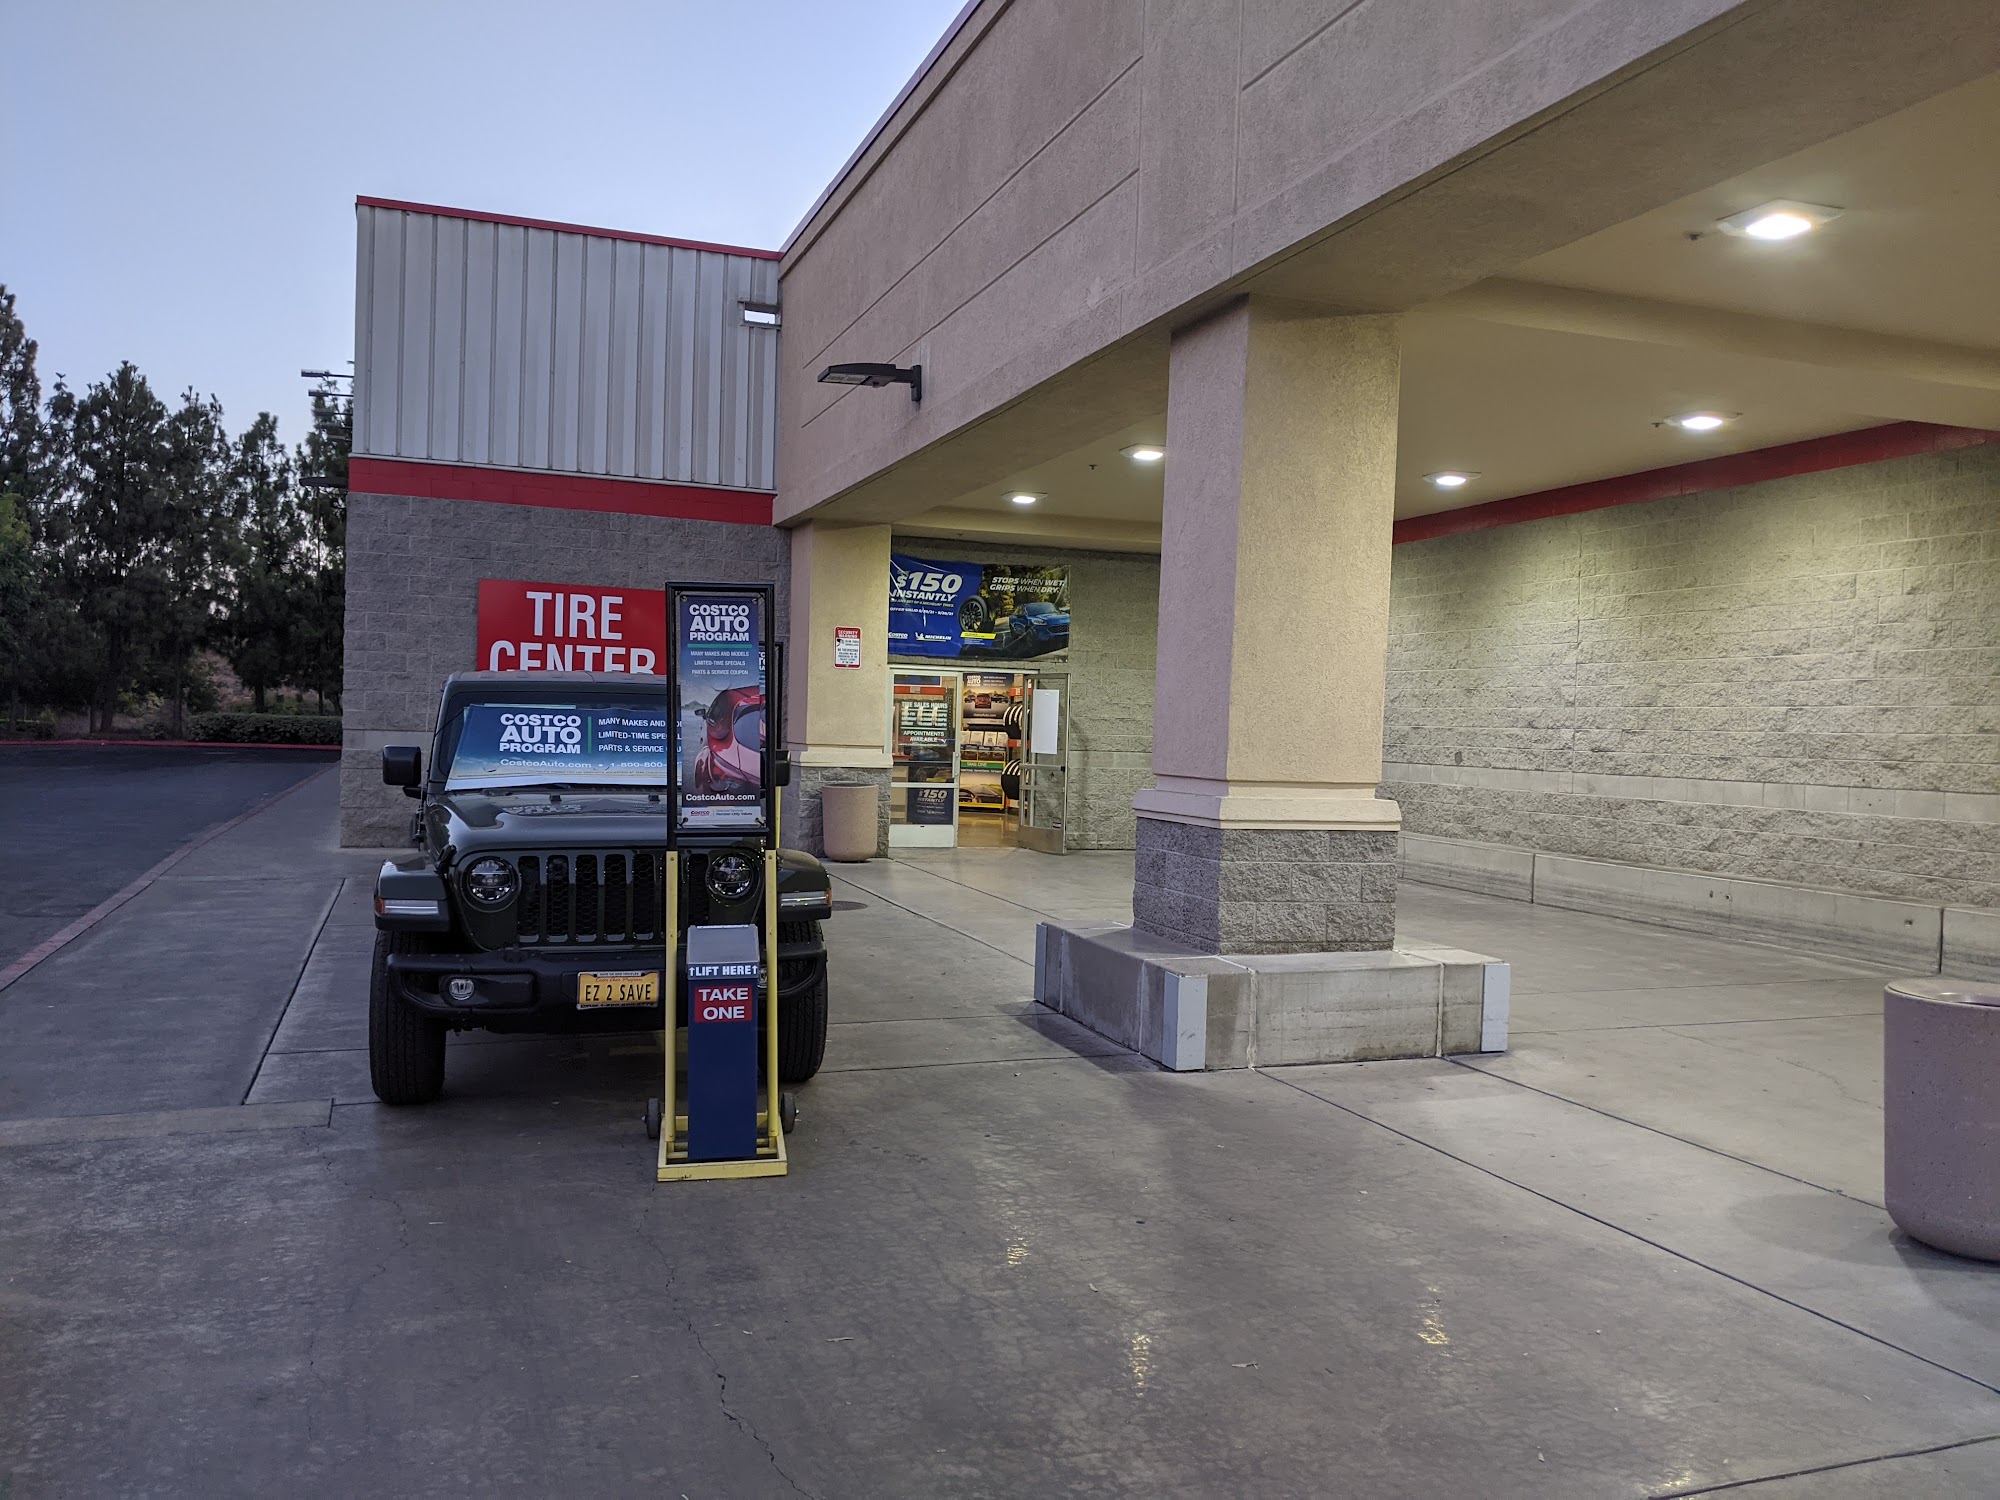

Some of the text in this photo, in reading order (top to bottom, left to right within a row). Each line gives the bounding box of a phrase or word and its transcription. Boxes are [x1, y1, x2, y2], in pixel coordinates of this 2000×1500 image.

[896, 572, 963, 594] $150
[991, 576, 1065, 587] STOPS WHEN WET.
[989, 583, 1061, 594] GRIPS WHEN DRY.
[891, 589, 956, 602] INSTANTLY
[526, 591, 623, 640] TIRE
[689, 604, 750, 616] COSTCO
[689, 615, 750, 632] AUTO
[689, 632, 750, 642] PROGRAM
[888, 631, 909, 639] COSTCO
[500, 713, 582, 727] COSTCO
[598, 717, 621, 726] MANY
[621, 718, 648, 727] MAKES
[499, 725, 582, 744] AUTO
[598, 730, 650, 740] LIMITED-TIME
[499, 742, 581, 754] PROGRAM
[598, 743, 623, 752] PARTS
[632, 745, 664, 753] SERVICE
[500, 758, 592, 768] CostcoAuto.com
[685, 793, 755, 801] CostcoAuto.com
[918, 789, 948, 799] $150
[695, 964, 752, 976] LIFT HERE
[585, 983, 652, 1001] EZ 2 SAVE
[698, 987, 749, 1002] TAKE
[702, 1005, 745, 1021] ONE
